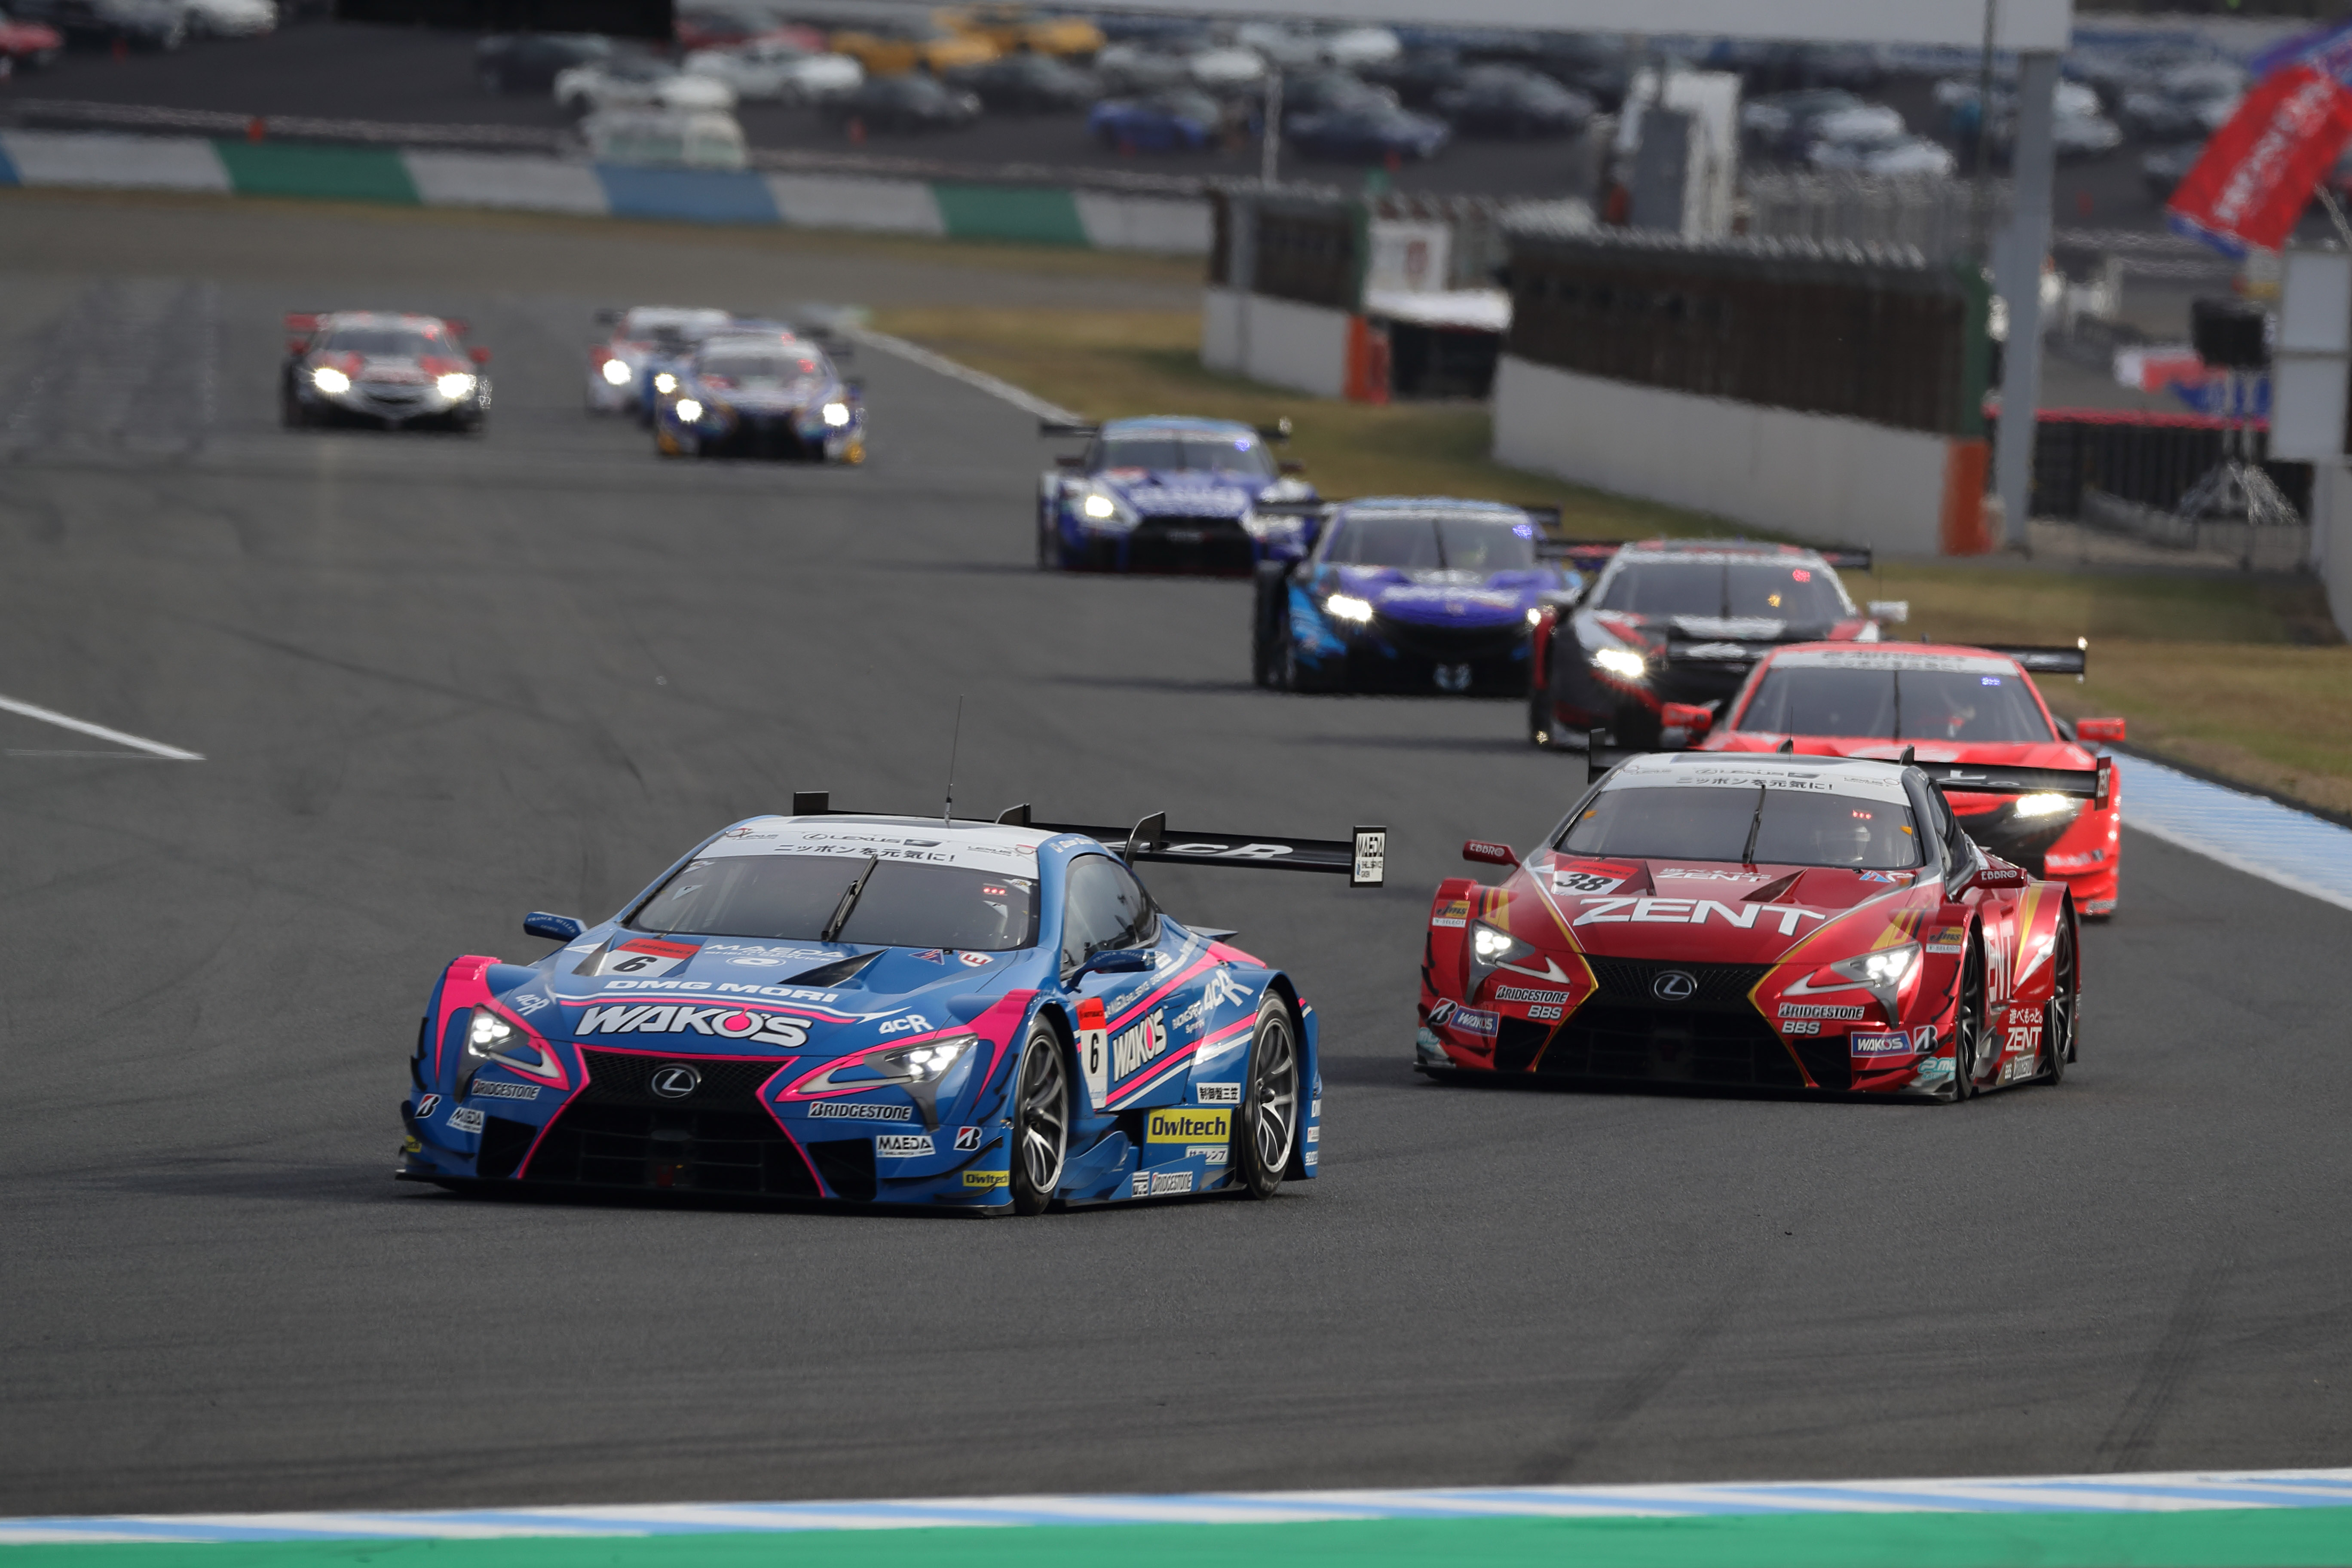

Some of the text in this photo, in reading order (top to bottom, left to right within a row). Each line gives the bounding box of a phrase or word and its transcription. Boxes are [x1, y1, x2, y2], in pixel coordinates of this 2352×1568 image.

[830, 835, 901, 844] LEXUS
[774, 844, 956, 862] ニッポンを元気に!
[1556, 873, 1614, 891] 38
[1656, 872, 1771, 882] ZENT
[1981, 870, 2017, 881] EBBRO
[1573, 897, 1826, 937] ZENT
[704, 944, 844, 958] MAEDA
[612, 956, 658, 972] 6
[604, 980, 839, 1003] DMG MORI
[1204, 968, 1255, 1010] 4CR
[1497, 986, 1568, 1003] BRIDGESTONE
[514, 994, 550, 1016] 4CR
[1528, 1005, 1563, 1020] BBS
[1779, 1003, 1864, 1020] BRIDGESTONE
[575, 1005, 813, 1048] WAKO'S
[879, 1014, 934, 1035] 4CR
[1782, 1021, 1821, 1035] BBS
[2006, 1026, 2042, 1051] ZENT
[1091, 1032, 1099, 1074] 6
[472, 1079, 540, 1099] BRIDGESTONE
[809, 1102, 912, 1120] BRIDGESTONE
[1152, 1115, 1226, 1136] Owltech
[878, 1136, 931, 1150] MAEDA
